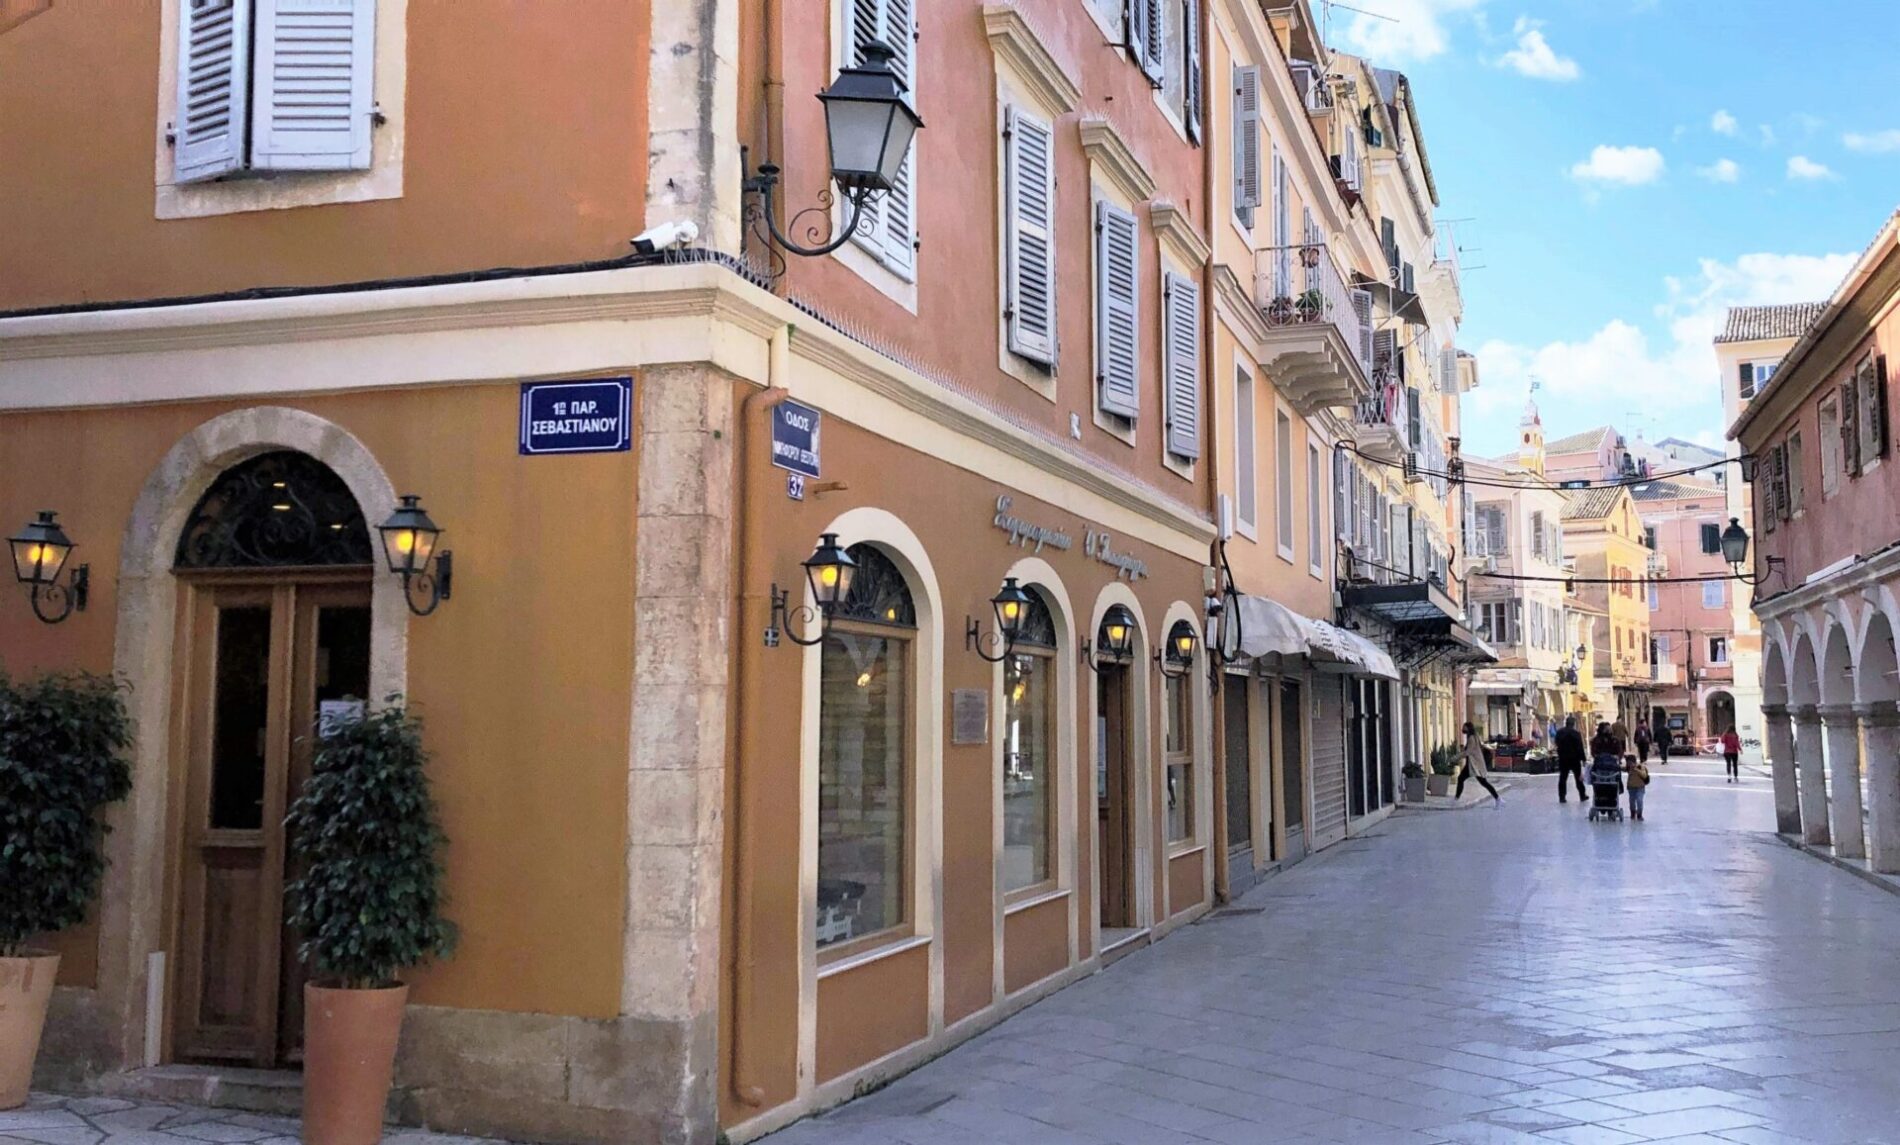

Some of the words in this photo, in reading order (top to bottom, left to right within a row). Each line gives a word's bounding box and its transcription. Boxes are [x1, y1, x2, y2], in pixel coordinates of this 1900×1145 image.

[571, 401, 598, 414] ΠΑΡ.
[532, 418, 617, 435] ΣΕΒΑΣΤΙΑΝΟΥ
[786, 411, 809, 431] ΟΔΟΣ
